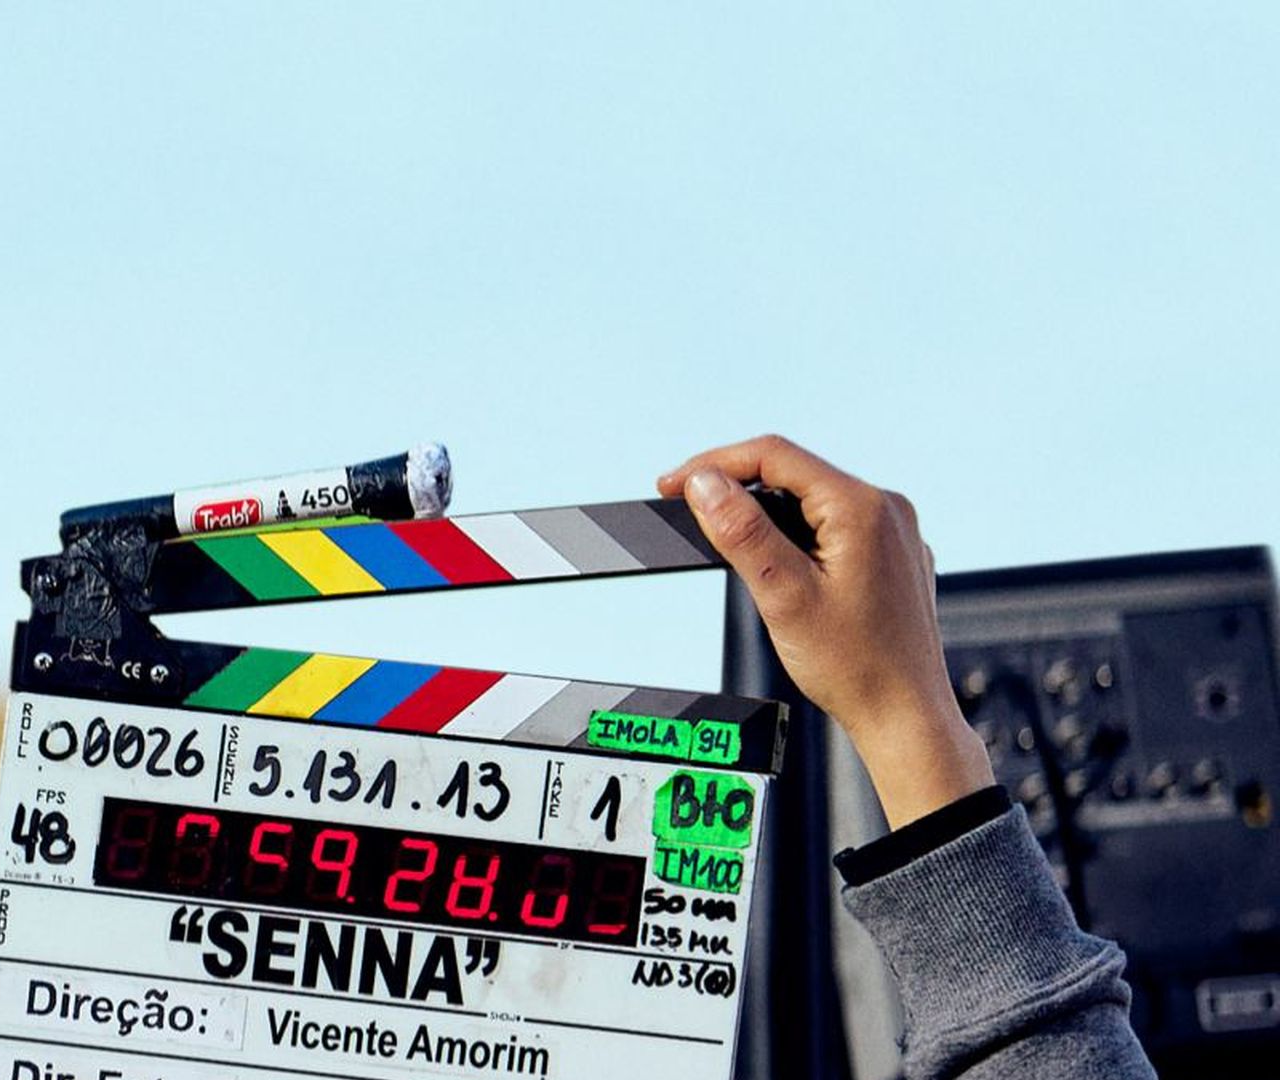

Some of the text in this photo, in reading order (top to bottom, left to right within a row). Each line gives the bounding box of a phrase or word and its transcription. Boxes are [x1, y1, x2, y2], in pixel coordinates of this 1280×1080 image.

[301, 484, 349, 510] 450
[17, 702, 33, 758] ROLL
[38, 716, 205, 777] 00026
[697, 727, 732, 758] 94
[222, 725, 239, 796] SCENE
[36, 788, 66, 804] FPS
[549, 761, 564, 818] TAKE
[590, 775, 622, 842] 1
[11, 802, 76, 865] 48
[644, 887, 687, 914] 50
[641, 922, 683, 949] 135
[26, 979, 208, 1036] Direção:
[268, 1008, 550, 1078] Vicente Amorim
